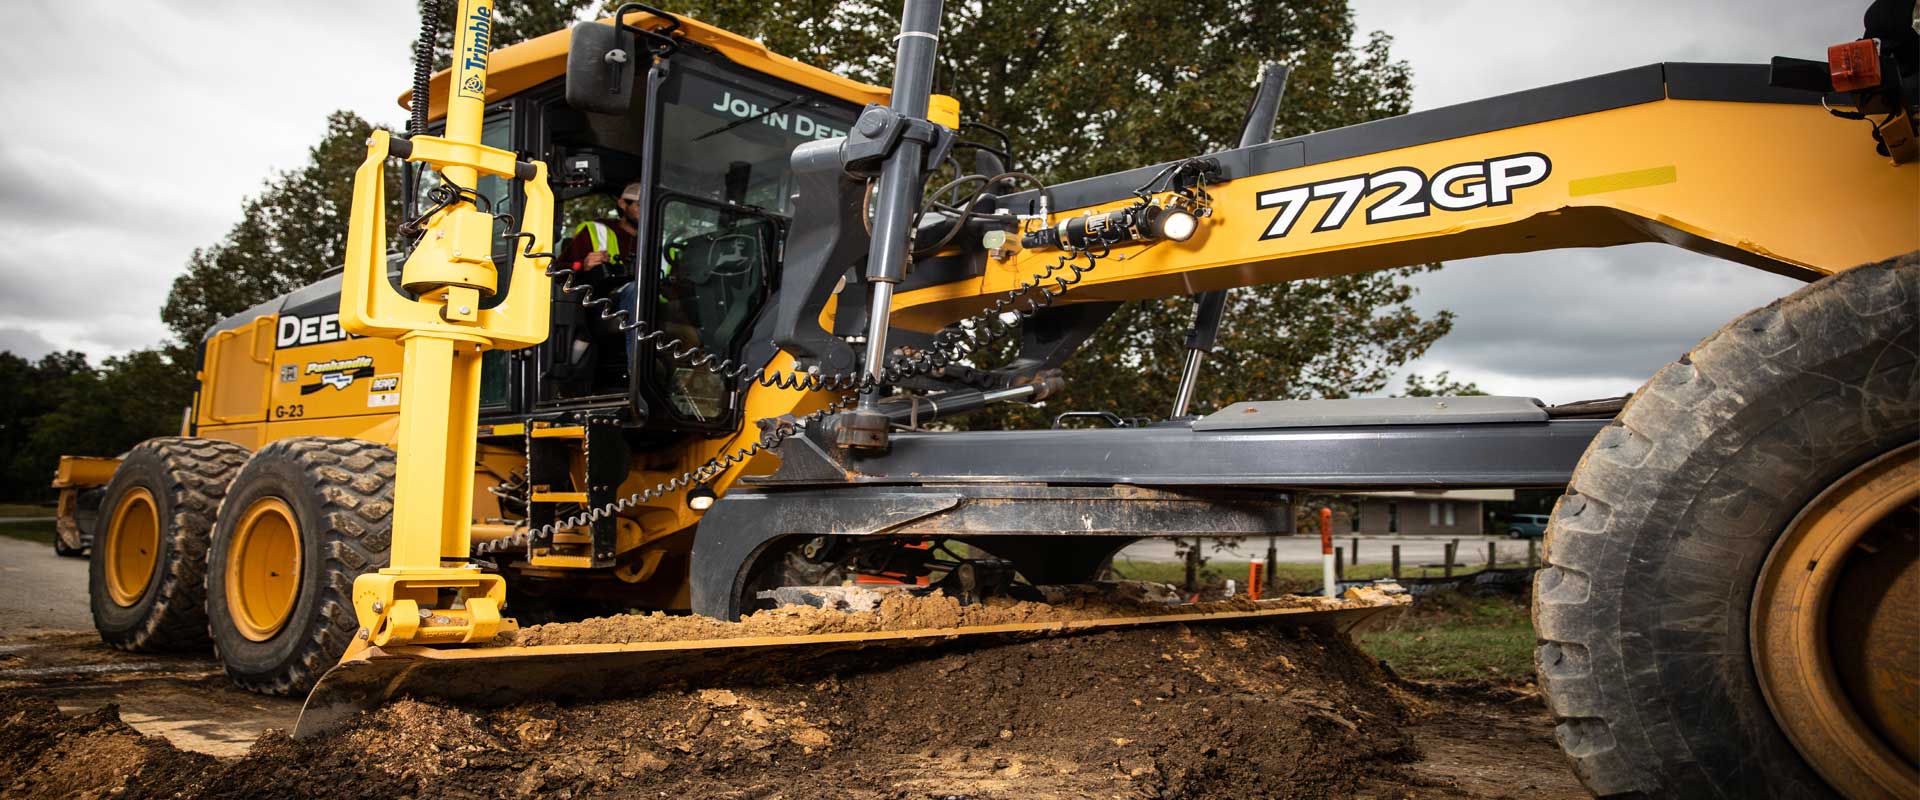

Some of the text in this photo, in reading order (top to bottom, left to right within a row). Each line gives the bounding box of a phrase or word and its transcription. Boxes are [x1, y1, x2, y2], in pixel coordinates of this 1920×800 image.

[465, 6, 491, 70] Trimble
[712, 91, 847, 140] JOHN DEE
[1256, 152, 1552, 241] 772GP
[275, 404, 304, 418] G-23
